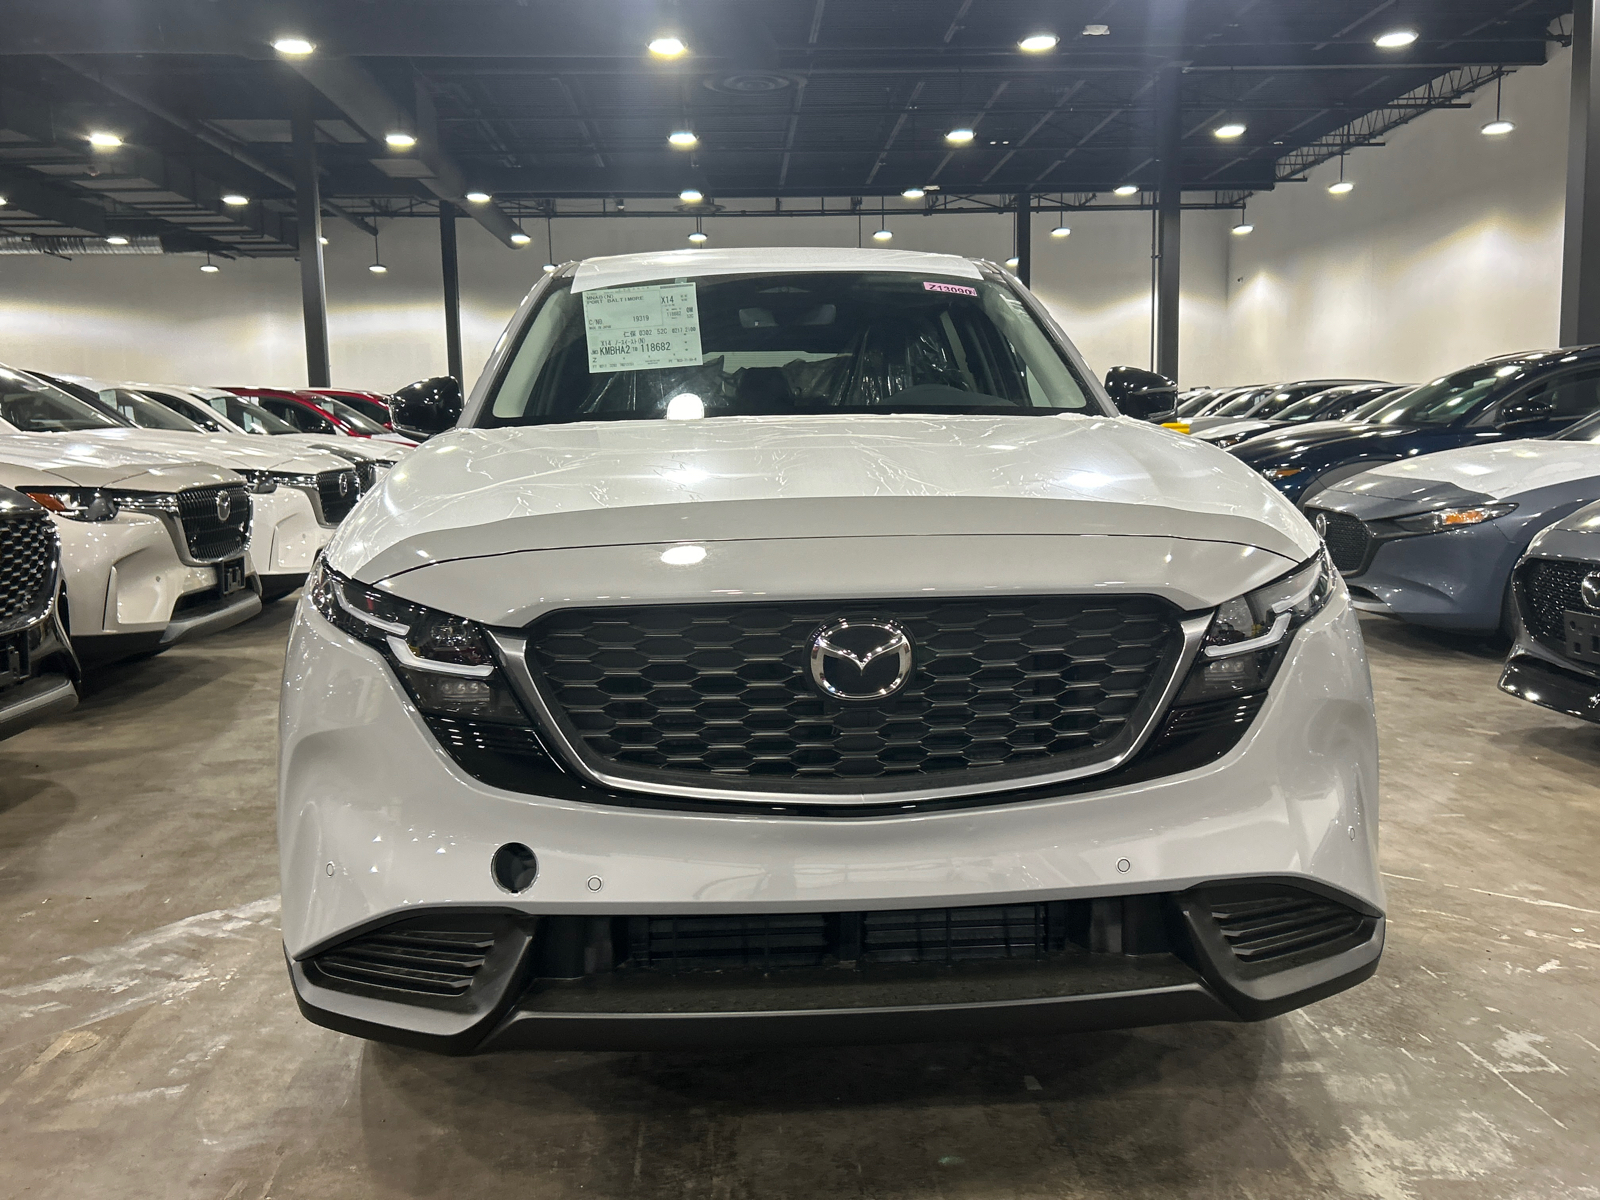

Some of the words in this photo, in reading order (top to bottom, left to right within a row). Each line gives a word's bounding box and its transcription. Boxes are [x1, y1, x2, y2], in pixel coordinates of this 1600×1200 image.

[607, 296, 644, 304] BALTIMORE
[661, 296, 675, 304] X14
[599, 345, 631, 356] KMBHA2
[641, 342, 671, 353] 118682
